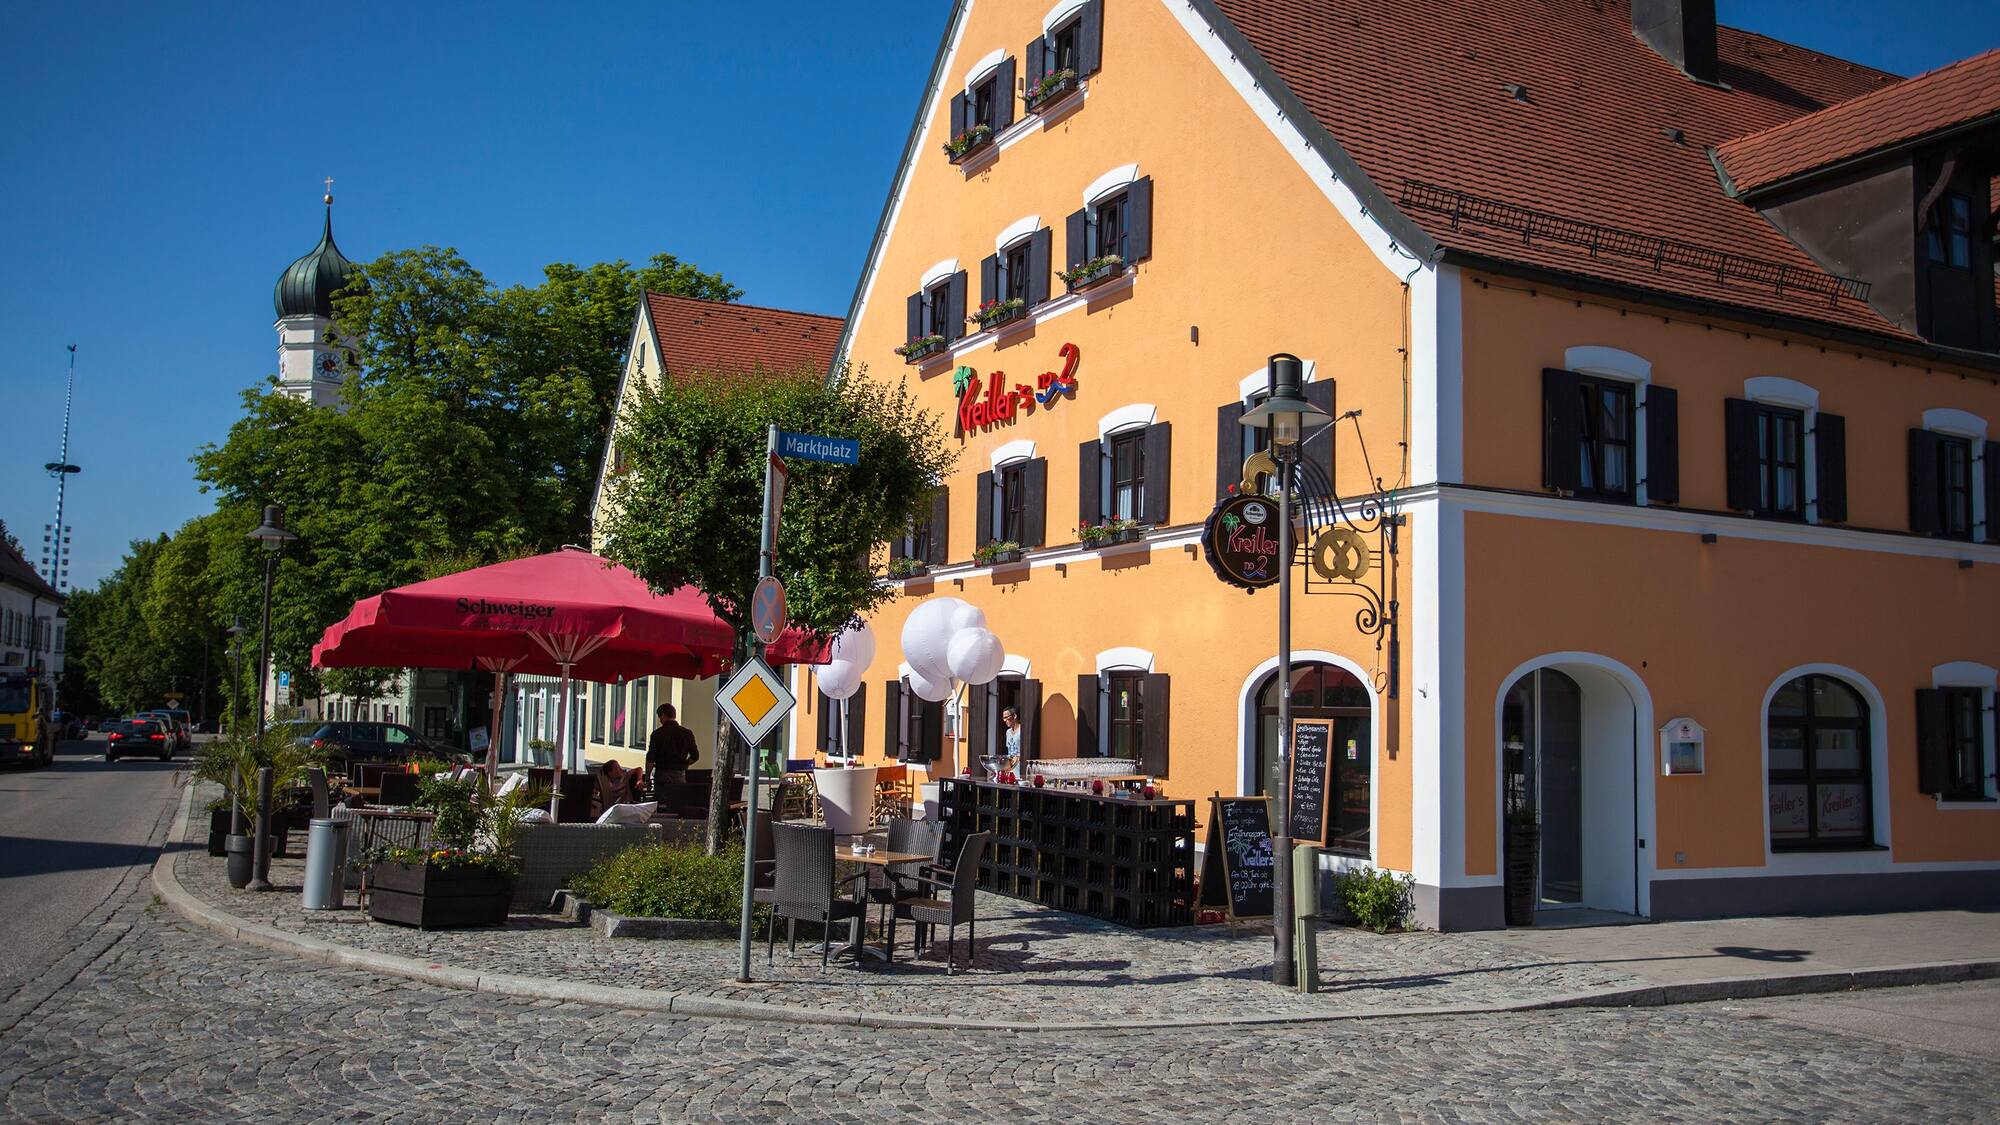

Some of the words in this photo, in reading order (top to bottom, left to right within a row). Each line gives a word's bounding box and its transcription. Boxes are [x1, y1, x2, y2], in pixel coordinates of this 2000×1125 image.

[959, 371, 1035, 432] Kreiller's
[1058, 343, 1079, 383] 2
[786, 437, 852, 459] Marktplatz
[1257, 555, 1267, 571] 2
[456, 597, 556, 619] Schweiger
